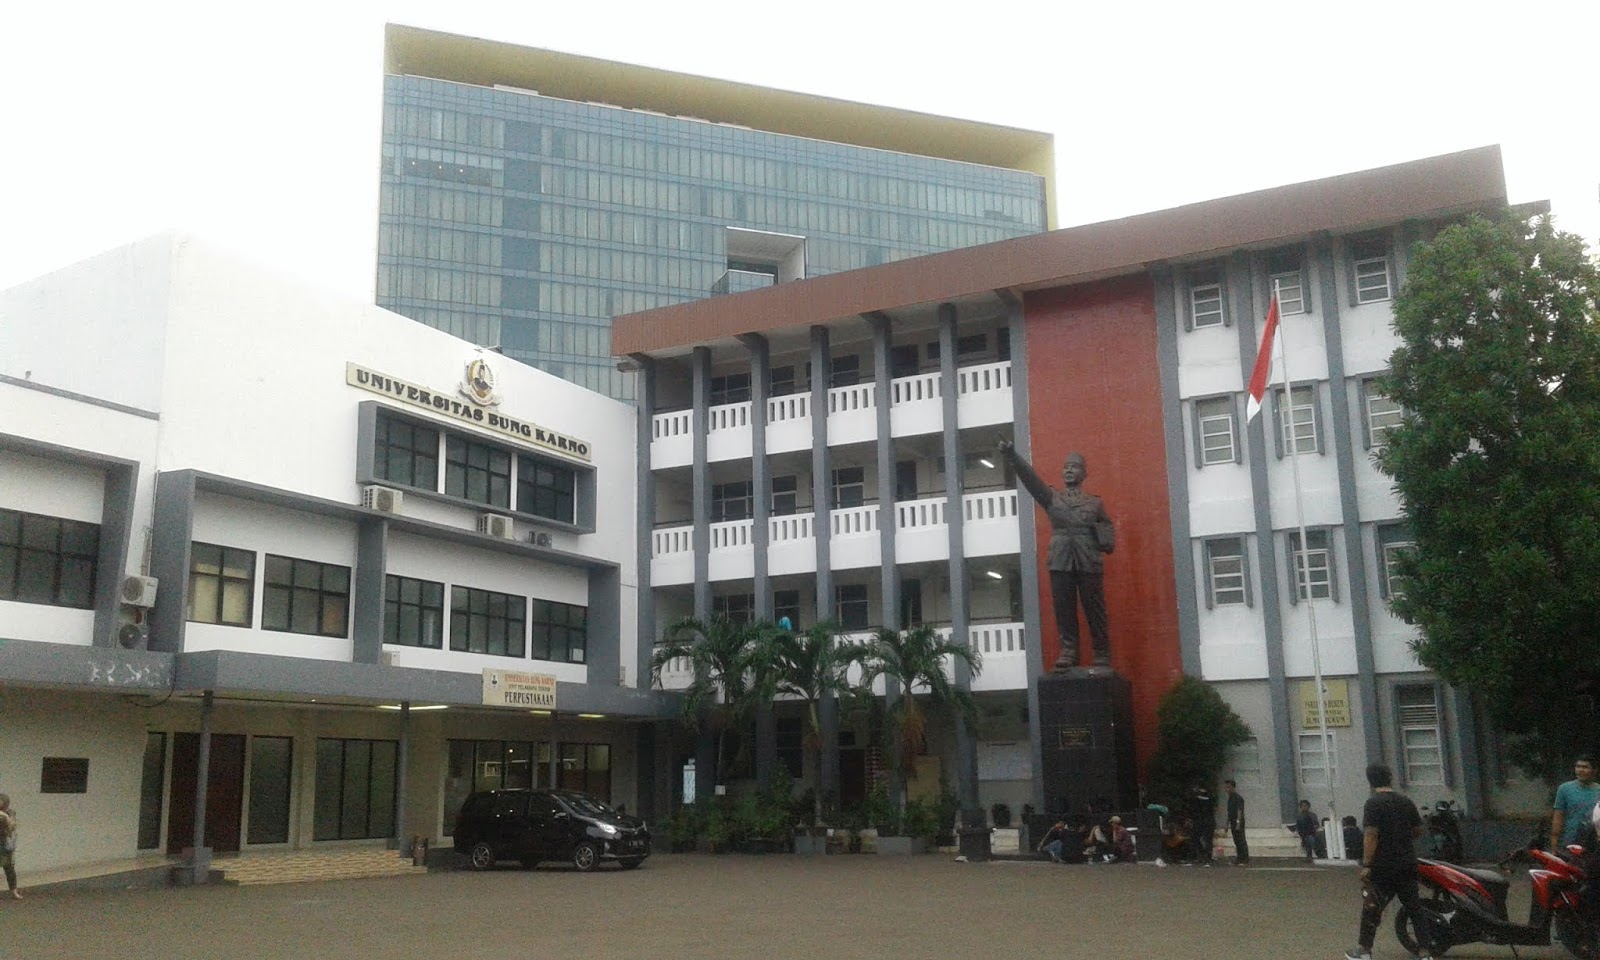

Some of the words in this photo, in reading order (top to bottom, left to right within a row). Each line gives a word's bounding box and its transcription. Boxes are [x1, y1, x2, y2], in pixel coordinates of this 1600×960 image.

[356, 369, 483, 421] UNIVERSITAS
[488, 412, 532, 437] BUNG
[535, 428, 588, 456] KARNO
[505, 692, 554, 705] PERPUSTAKAAN
